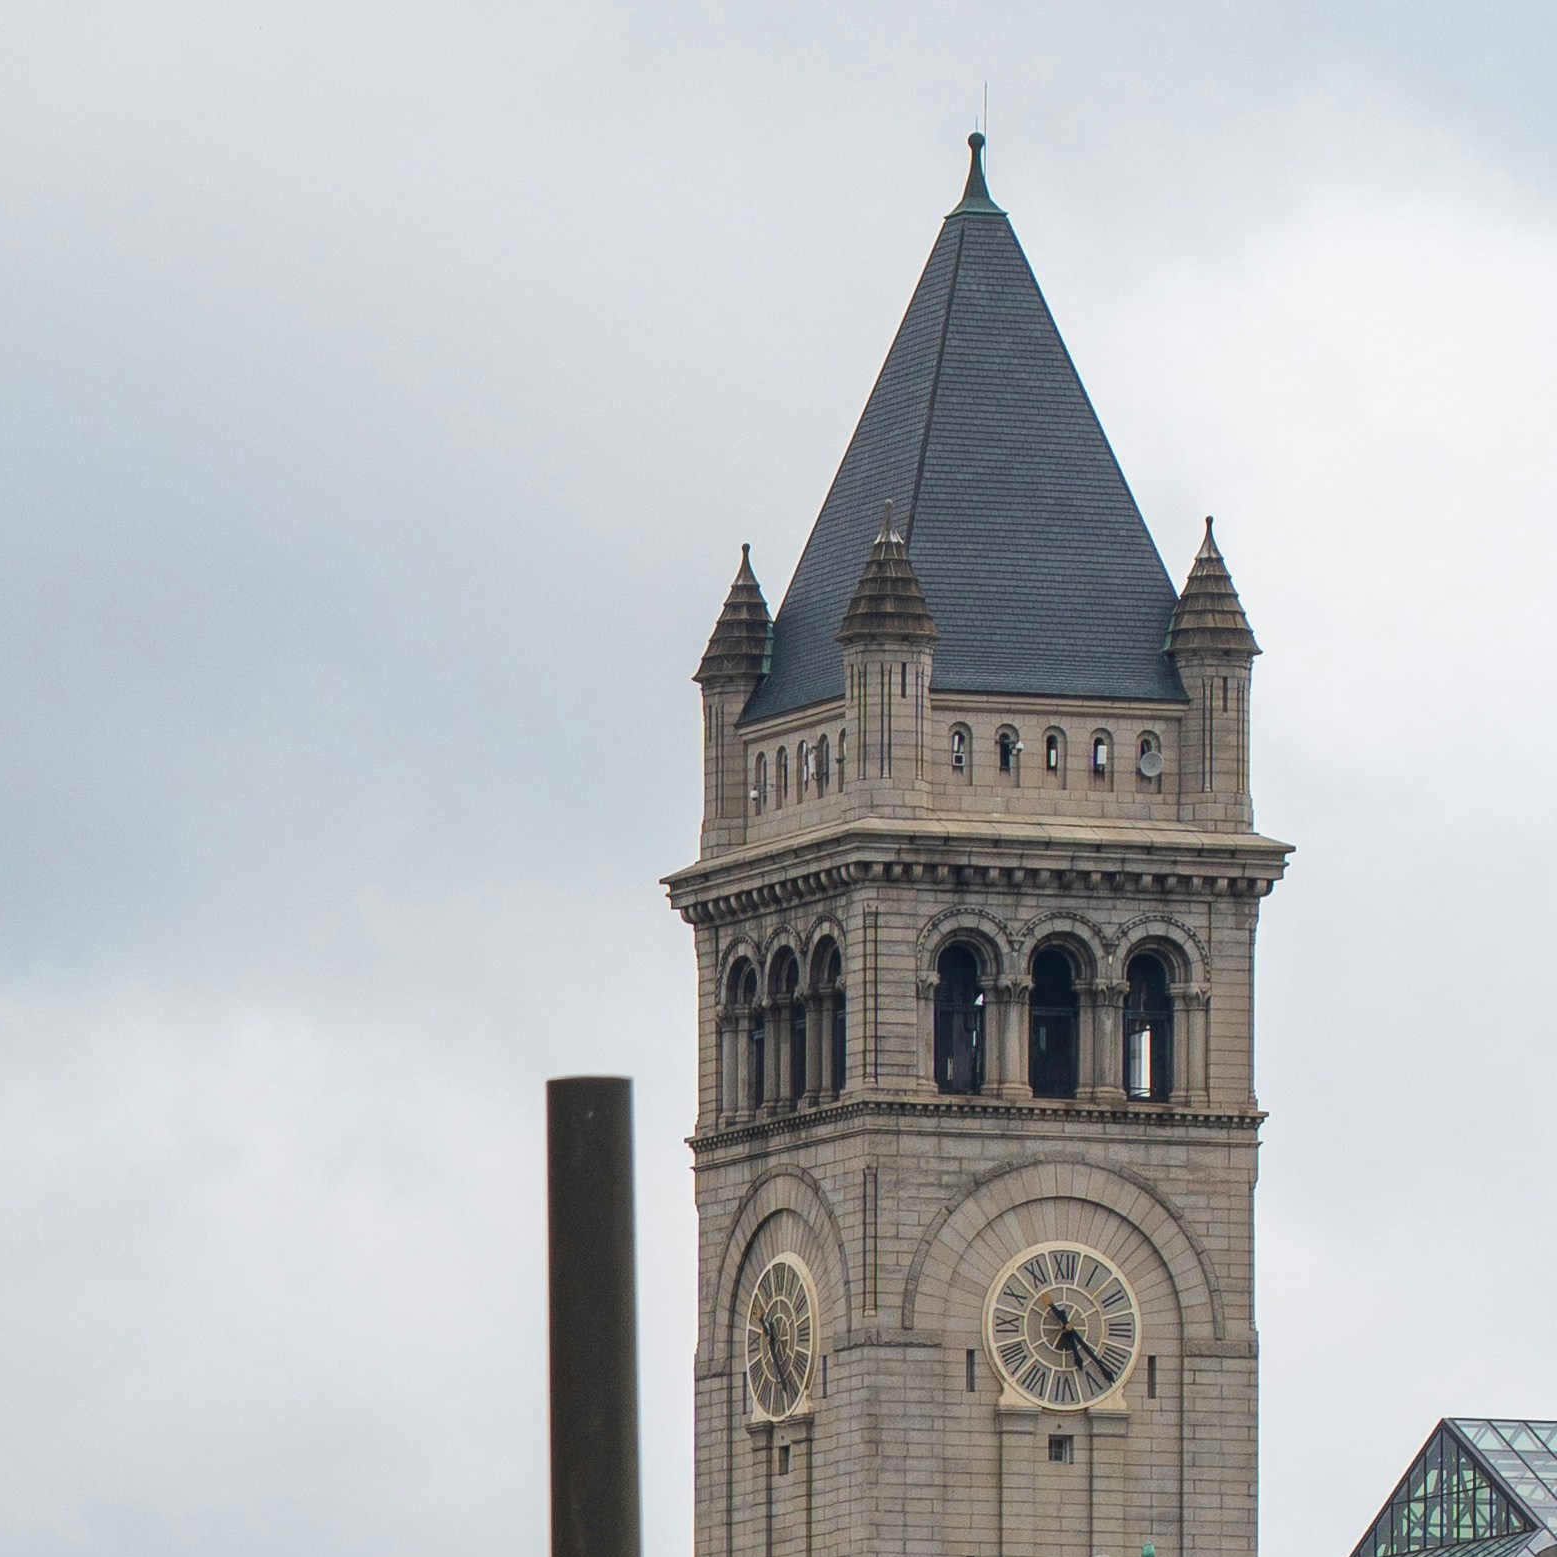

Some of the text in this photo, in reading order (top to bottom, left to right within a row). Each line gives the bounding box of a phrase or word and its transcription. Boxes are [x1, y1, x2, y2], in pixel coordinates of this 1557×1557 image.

[1025, 1259, 1047, 1288] XI
[1054, 1254, 1075, 1280] XII
[1085, 1265, 1098, 1287] I
[1003, 1285, 1027, 1306] X
[1102, 1290, 1124, 1308] II
[996, 1316, 1019, 1333] IX
[1109, 1322, 1132, 1338] III
[1000, 1342, 1028, 1375] VIII
[1100, 1347, 1127, 1376] IIII
[1021, 1365, 1046, 1397] VII
[1055, 1376, 1074, 1401] VI
[1085, 1371, 1103, 1396] V
